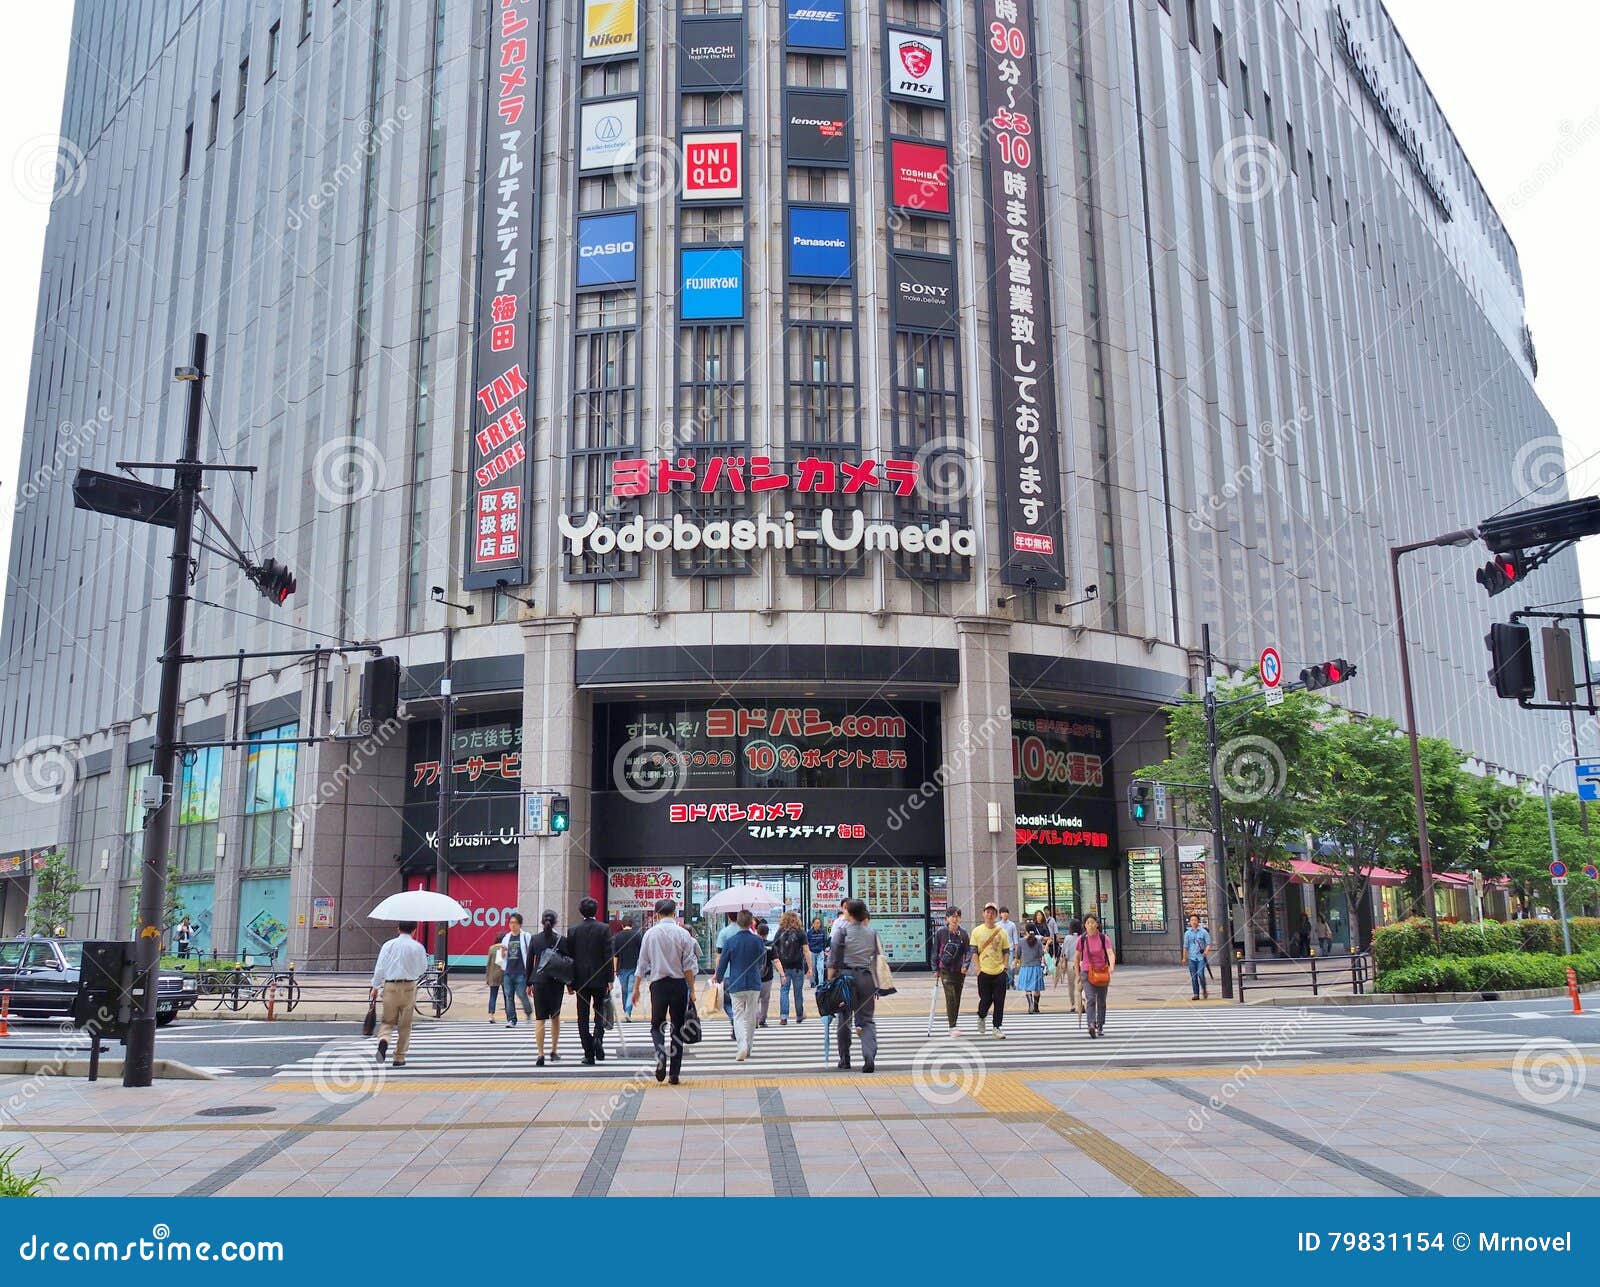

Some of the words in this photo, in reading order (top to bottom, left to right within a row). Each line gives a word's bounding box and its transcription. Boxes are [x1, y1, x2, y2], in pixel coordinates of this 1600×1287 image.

[588, 32, 633, 48] Nikon
[690, 46, 734, 55] HITACHI
[900, 81, 933, 94] msi
[791, 116, 830, 126] lenovo
[692, 148, 729, 164] UNI
[692, 167, 732, 187] QLO
[901, 168, 939, 180] TOSHIBA
[580, 241, 634, 258] CASIO
[793, 237, 846, 248] Panasonic
[900, 282, 950, 297] SONY
[476, 363, 528, 416] TAX
[475, 406, 527, 456] FREE
[475, 440, 526, 488] STORE
[612, 456, 920, 497] ヨドバシカメラ
[558, 507, 976, 557] Yodobashi-Umeda
[705, 707, 907, 738] ヨドバシ.com
[669, 803, 804, 823] ヨドバシカメラ
